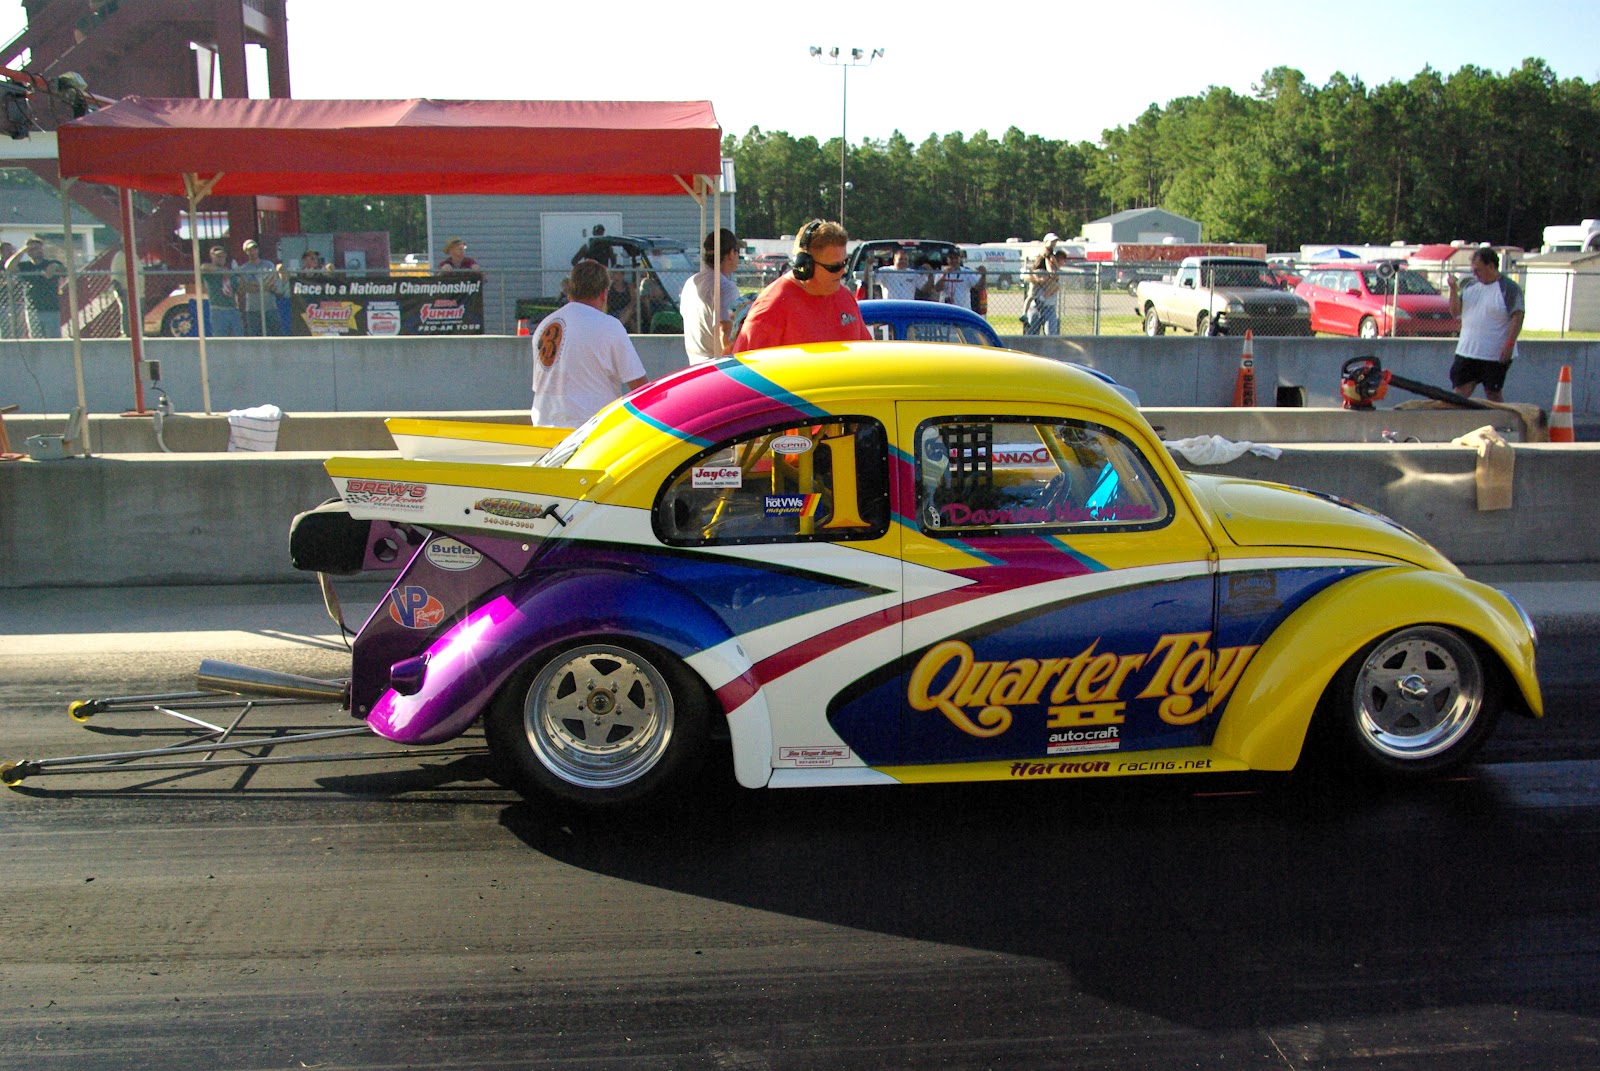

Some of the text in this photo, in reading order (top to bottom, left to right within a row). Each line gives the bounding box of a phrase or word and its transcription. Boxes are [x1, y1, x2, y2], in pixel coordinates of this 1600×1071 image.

[294, 281, 481, 296] Race to a National Championship!
[695, 468, 739, 485] JayCee
[818, 434, 872, 529] 1
[346, 480, 427, 497] DREW'S
[481, 497, 542, 513] GERMAN
[766, 507, 805, 516] magazine
[941, 503, 1050, 525] Damon
[391, 586, 428, 629] VP
[416, 609, 444, 622] Racing
[908, 631, 1261, 738] Quarter Toy
[1047, 701, 1126, 728] II
[1049, 726, 1119, 742] autocraft
[1009, 761, 1110, 777] Harmon
